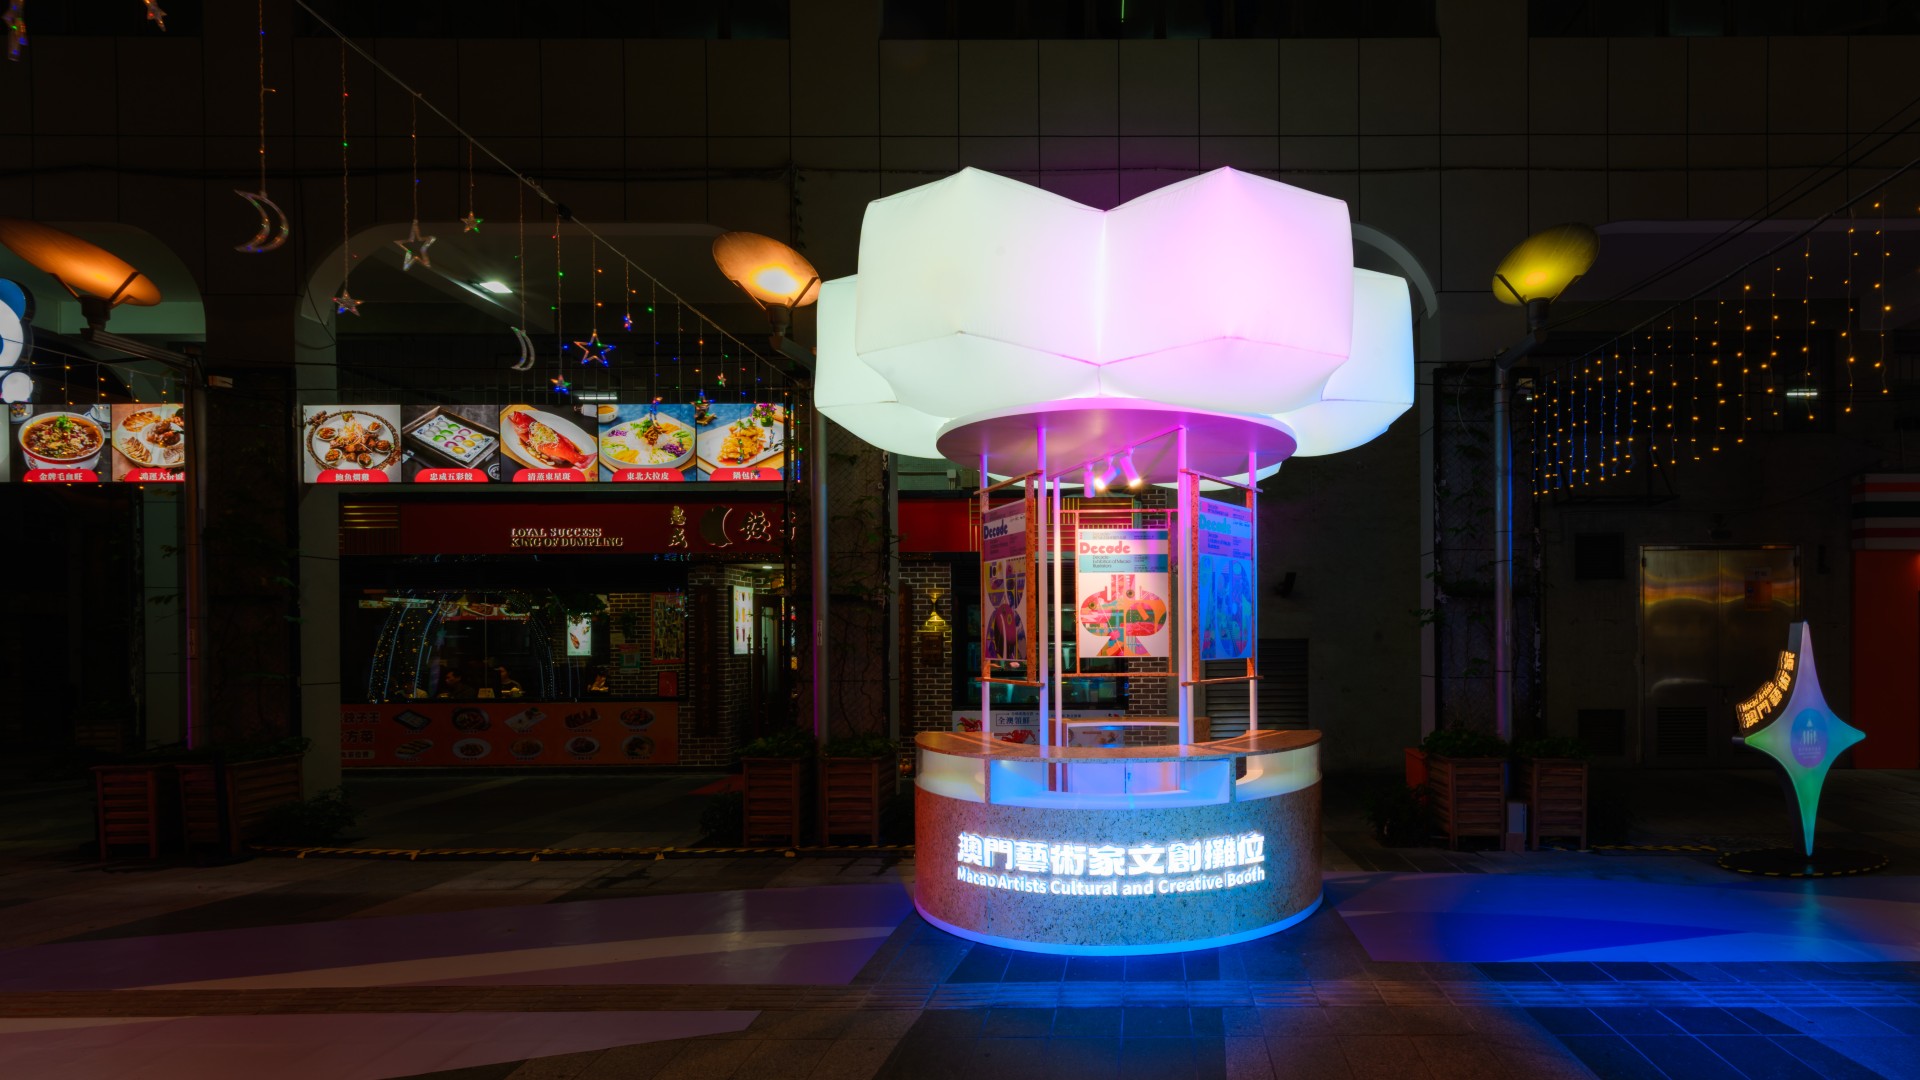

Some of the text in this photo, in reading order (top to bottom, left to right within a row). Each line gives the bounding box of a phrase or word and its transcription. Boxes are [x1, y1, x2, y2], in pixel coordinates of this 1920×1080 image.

[626, 472, 669, 481] 東北大拉皮
[510, 528, 603, 538] LOYAL SUCCESS
[510, 537, 624, 548] KING OF DUMPLING
[957, 831, 1265, 876] 澳門藝術家文創攤位
[956, 866, 1265, 896] Macao Artists Cultural and Creative Booth
